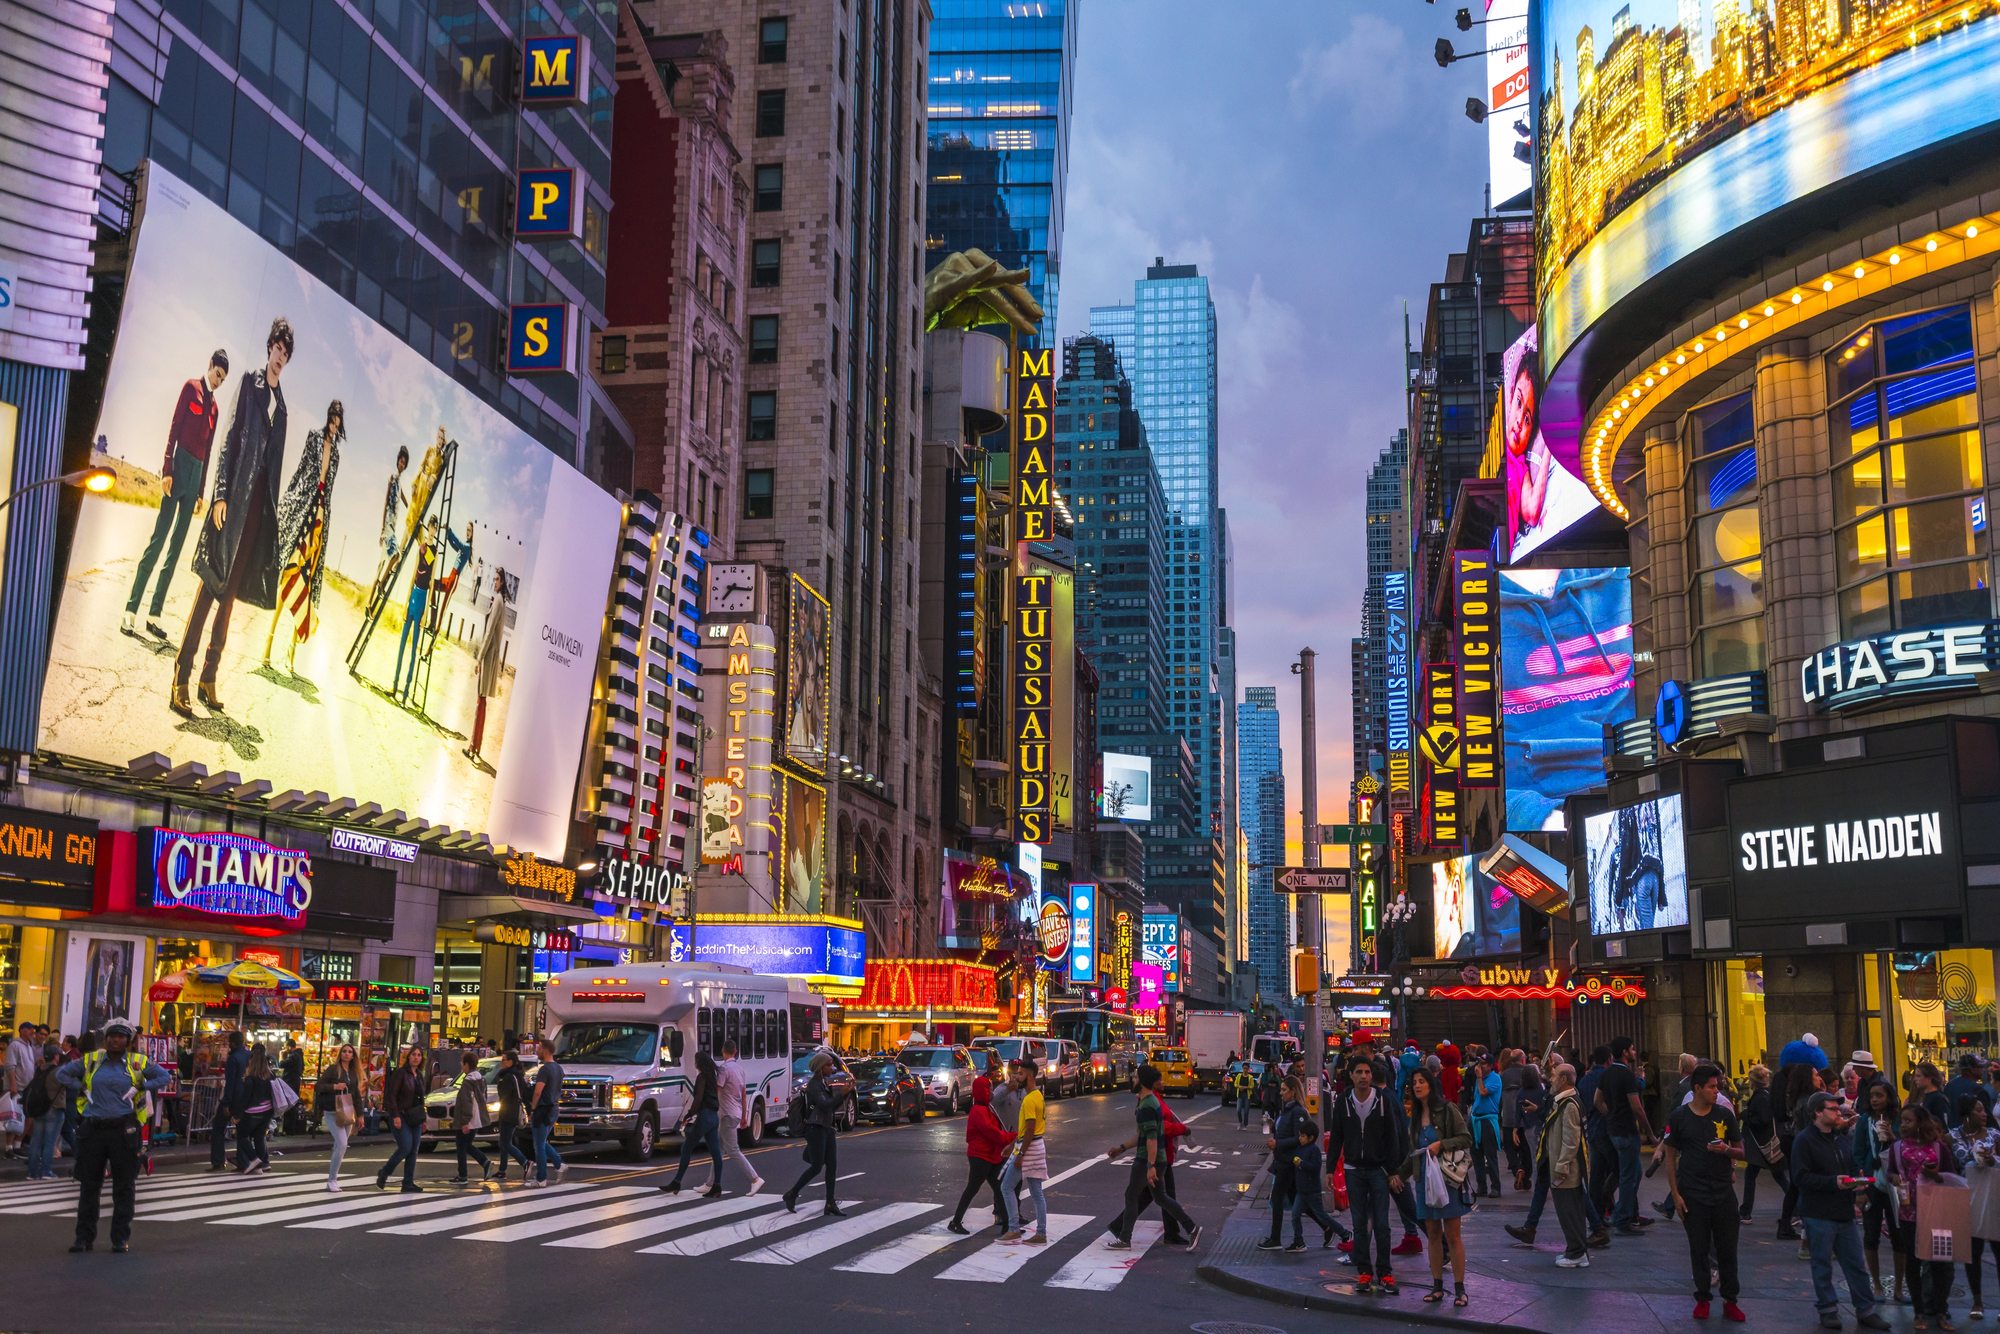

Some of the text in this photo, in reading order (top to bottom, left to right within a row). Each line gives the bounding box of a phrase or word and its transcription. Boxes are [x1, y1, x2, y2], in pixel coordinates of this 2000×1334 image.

[1019, 349, 1051, 539] MADAME
[1051, 569, 1071, 587] NOW
[1385, 572, 1406, 610] NEW
[729, 603, 735, 611] 6
[541, 624, 584, 658] CALVIN KLEIN
[708, 625, 729, 638] NEW
[1461, 559, 1494, 779] NEW VICTORY
[1801, 625, 1990, 704] CHASE
[1387, 677, 1410, 750] STUDIOS
[1502, 696, 1570, 715] SKECHERS
[1435, 790, 1457, 840] NEW
[333, 830, 416, 860] OUTFRONT PRIME
[1347, 827, 1372, 842] 7 Av
[1741, 812, 1942, 871] STEVE MADDEN
[65, 833, 96, 866] GA
[167, 838, 313, 911] CHAMPS
[505, 852, 577, 902] subway
[958, 879, 993, 894] Madame
[1285, 875, 1342, 886] ONE WAY
[556, 934, 561, 947] 2
[564, 935, 569, 948] 3
[1168, 923, 1176, 942] 3
[684, 943, 813, 956] AaddinTheMusical.com
[1120, 926, 1129, 990] EMPIRE
[460, 984, 480, 993] SEP
[1566, 980, 1623, 991] A Q R
[1578, 994, 1637, 1004] C E W
